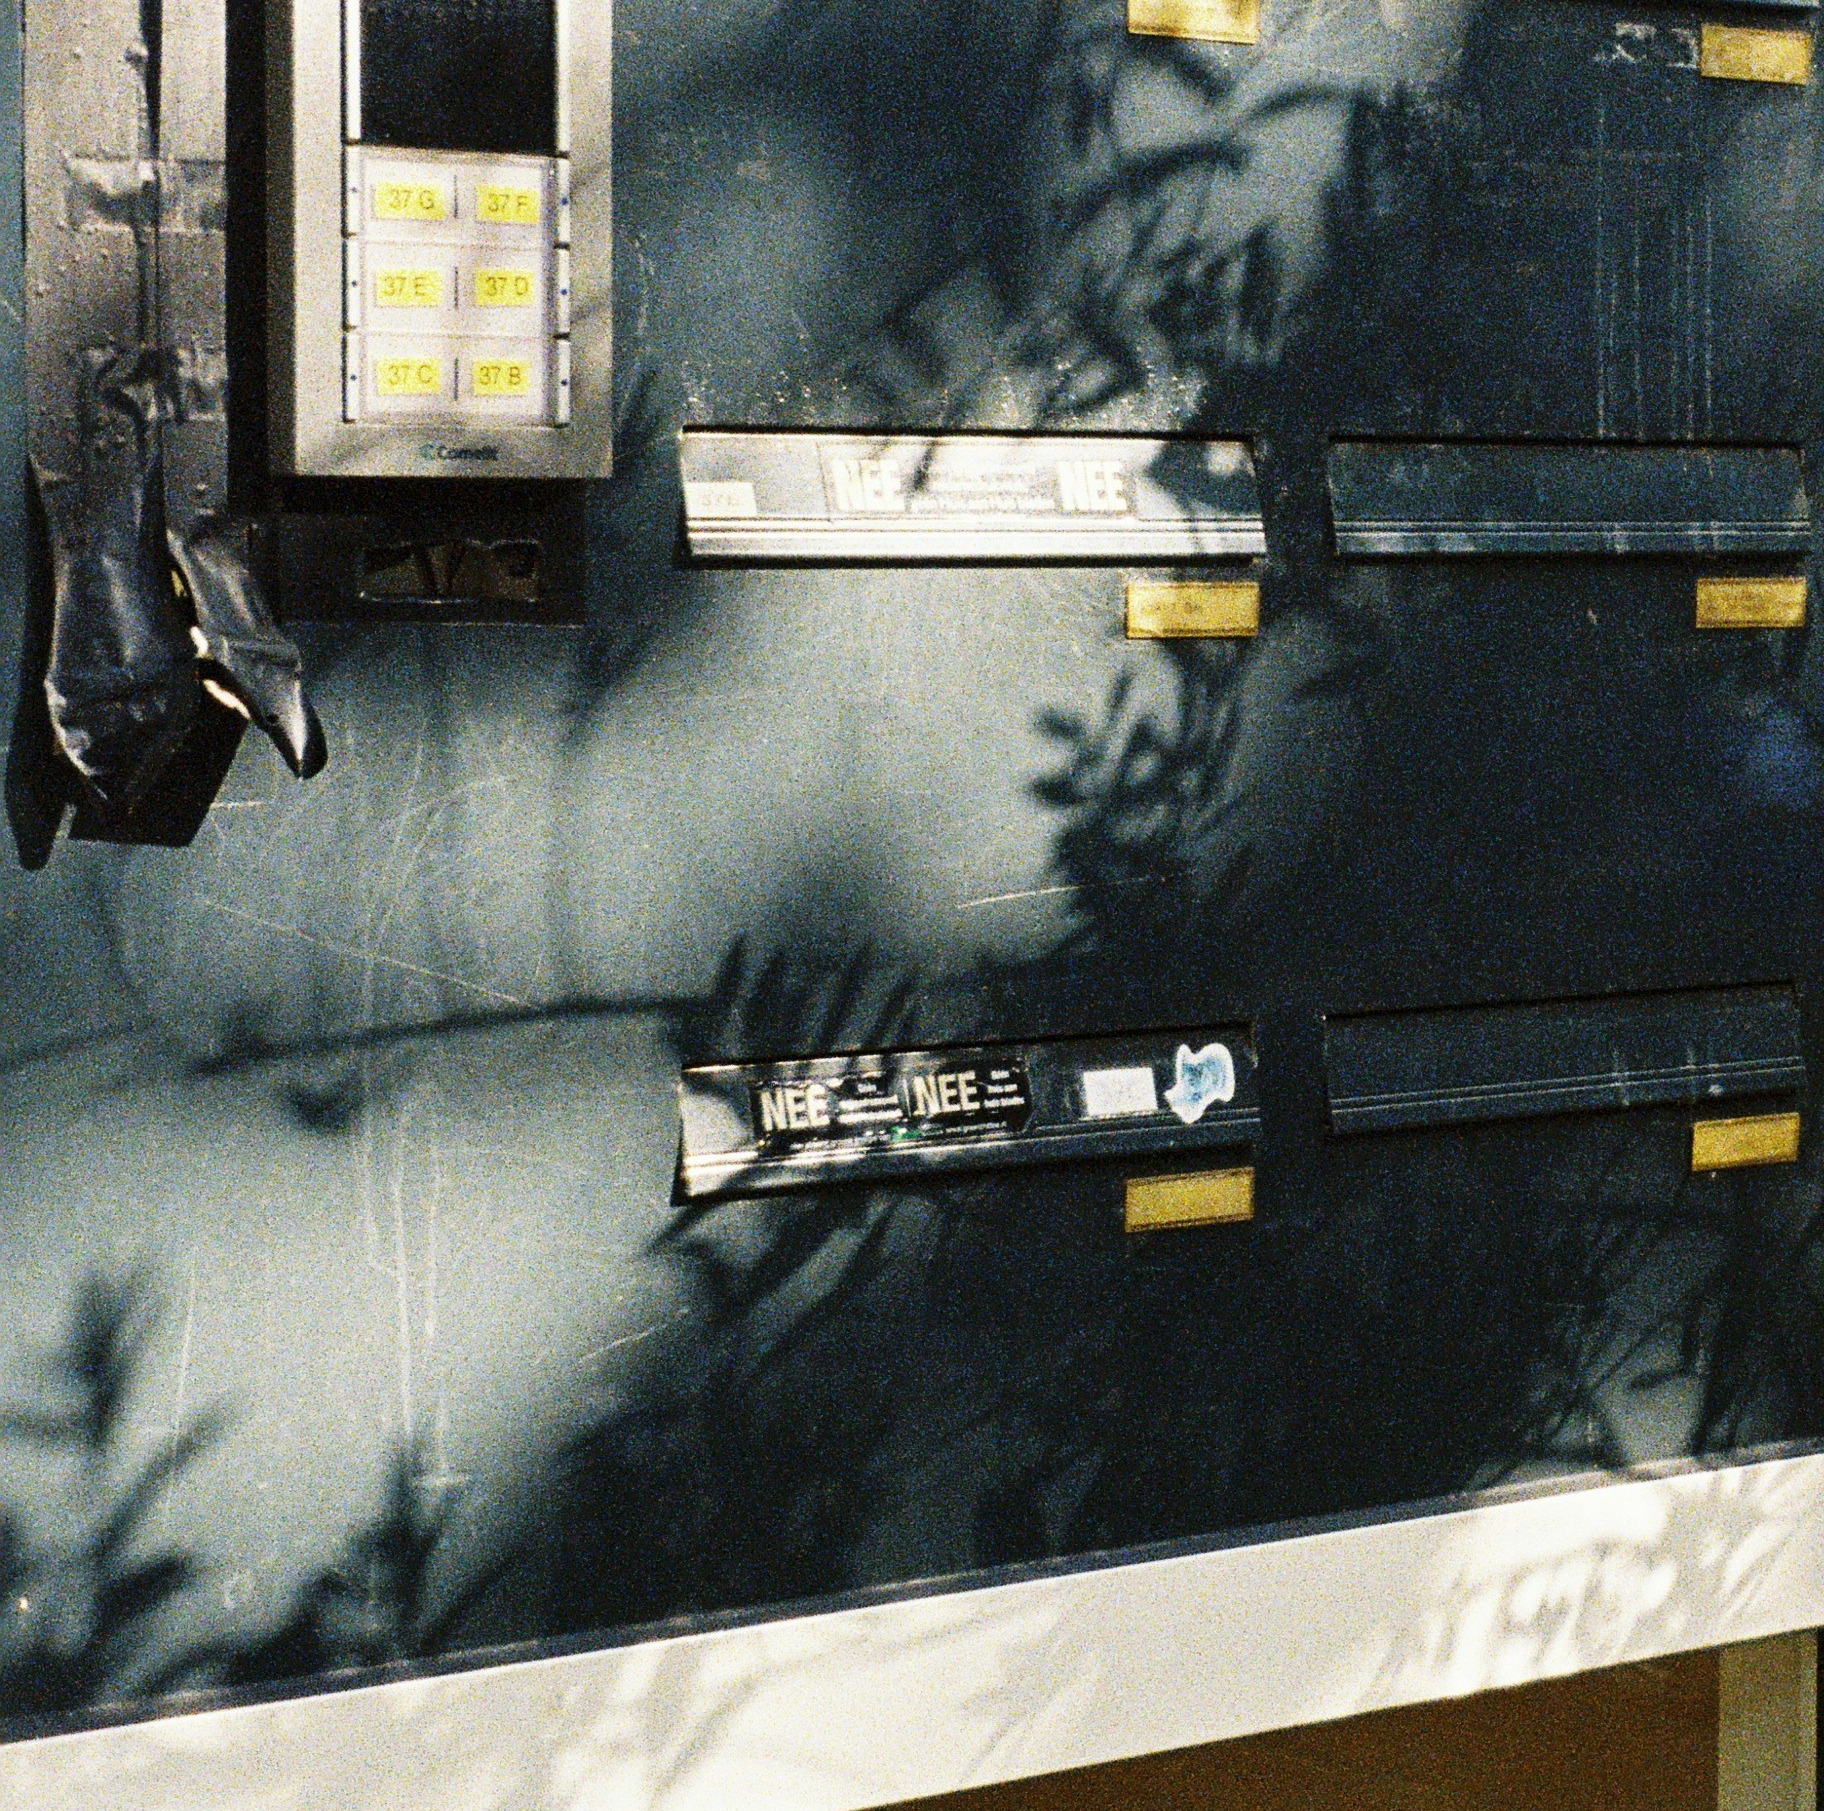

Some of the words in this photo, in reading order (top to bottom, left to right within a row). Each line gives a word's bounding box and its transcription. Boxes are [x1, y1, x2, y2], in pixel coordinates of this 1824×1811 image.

[389, 187, 411, 210] 37
[487, 192, 510, 213] 37
[384, 276, 407, 296] 37
[485, 276, 507, 297] 37
[387, 364, 410, 386] 37
[479, 366, 501, 386] 37
[832, 459, 905, 512] NEE
[1058, 459, 1130, 512] NEE
[913, 1070, 981, 1117] NEE
[760, 1084, 831, 1132] NEE
